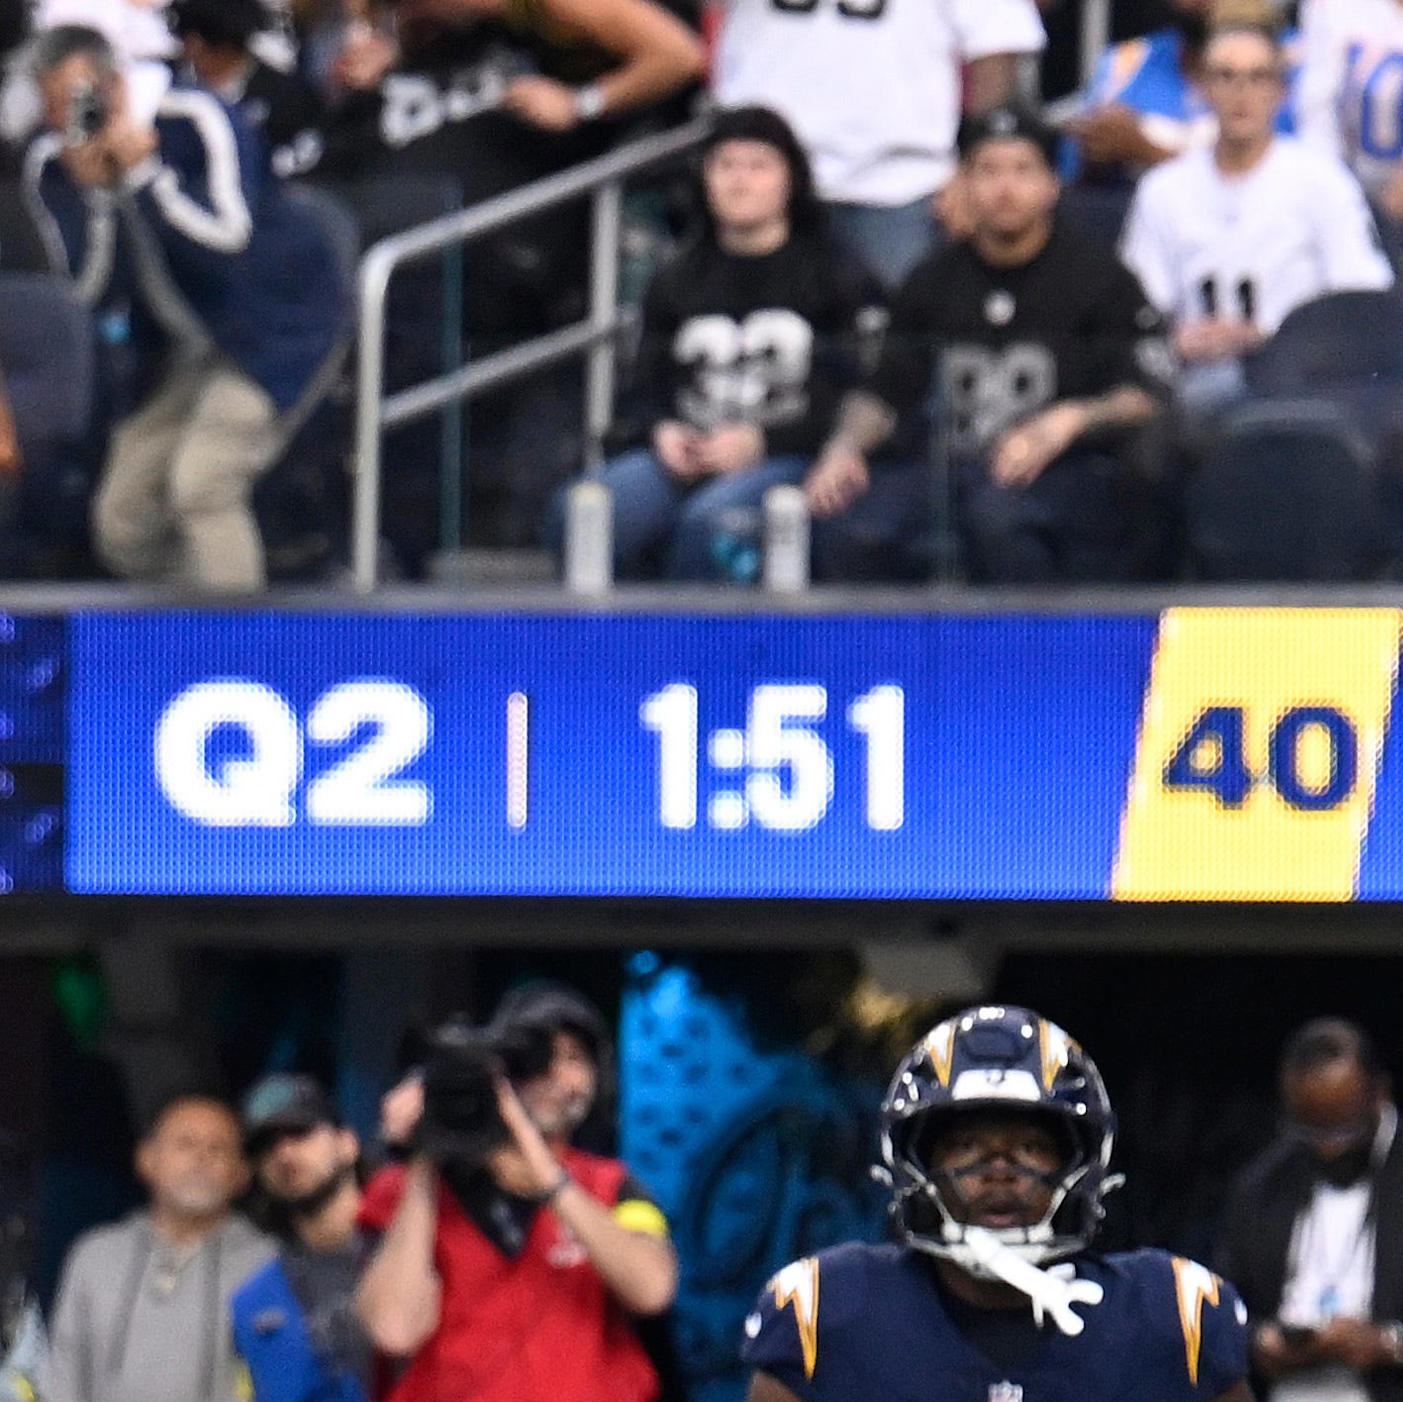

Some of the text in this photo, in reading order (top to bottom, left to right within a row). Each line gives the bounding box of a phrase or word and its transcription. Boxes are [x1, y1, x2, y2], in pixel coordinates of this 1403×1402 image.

[153, 677, 434, 829] Q2
[640, 681, 906, 832] 1:51
[1162, 705, 1361, 812] 40
